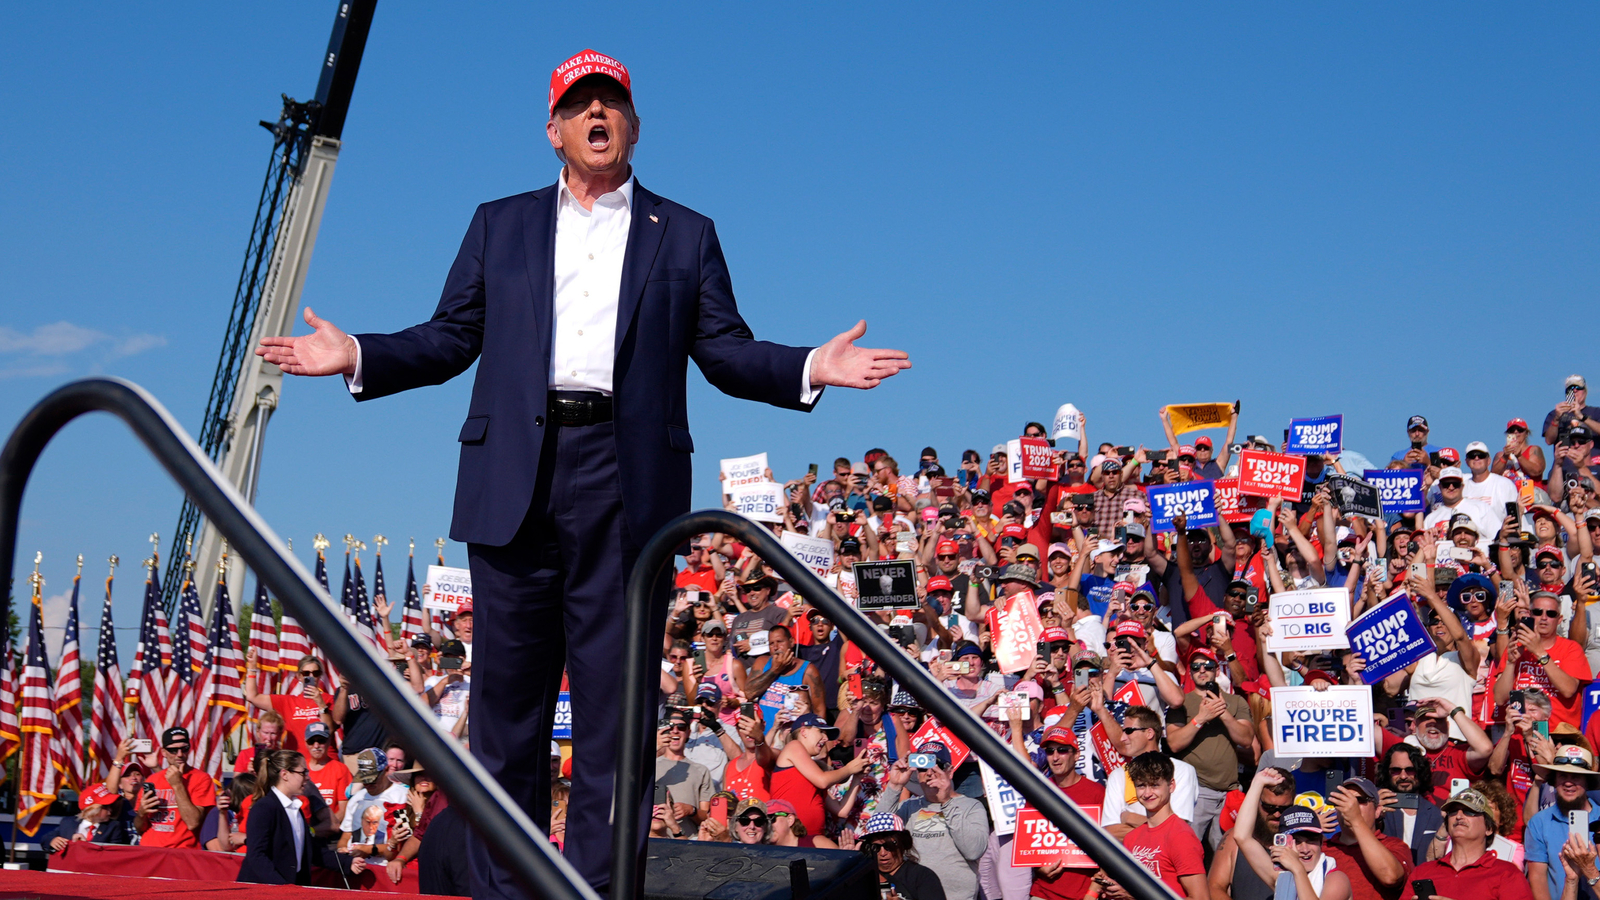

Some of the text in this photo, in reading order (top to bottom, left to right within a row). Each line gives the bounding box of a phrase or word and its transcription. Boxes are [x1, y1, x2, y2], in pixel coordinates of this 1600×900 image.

[556, 53, 627, 77] MAKE AMERICA
[563, 64, 622, 85] GREAT AGAIN
[1295, 422, 1338, 436] TRUMP
[1299, 433, 1332, 445] 2024
[1028, 455, 1051, 467] 2024
[1246, 458, 1300, 475] TRUMP
[729, 467, 760, 479] YOU'RE
[1252, 470, 1291, 486] 2024
[730, 475, 764, 488] FIRED!
[1367, 477, 1419, 489] TRUMP
[739, 494, 776, 504] YOU'RE
[1153, 488, 1210, 506] TRUMP
[1220, 497, 1248, 510] 024
[1163, 501, 1204, 517] 2024
[792, 544, 830, 555] JOE BIDEN
[794, 551, 830, 567] OU'RE
[438, 574, 453, 583] JOE
[862, 567, 906, 579] NEVER
[861, 594, 914, 605] SURRENDER
[1275, 602, 1337, 616] TOO BIG
[1011, 610, 1032, 652] 2024
[1281, 622, 1332, 636] TO RIG
[1353, 609, 1408, 650] TRUMP
[1364, 628, 1410, 662] 2024
[1364, 661, 1379, 674] TEXT
[1379, 652, 1398, 666] TRUMP
[1398, 647, 1407, 655] TO
[1529, 675, 1549, 683] 2024
[1285, 700, 1357, 709] CROOKED JOE
[1286, 709, 1357, 723] YOU'RE
[1281, 724, 1364, 743] FIRED!
[952, 744, 962, 756] TEXT
[993, 772, 1016, 825] RED!
[1285, 818, 1299, 826] GREAT
[1294, 811, 1314, 819] AMERICA
[1023, 819, 1060, 834] TRU
[911, 832, 945, 840] patagonia
